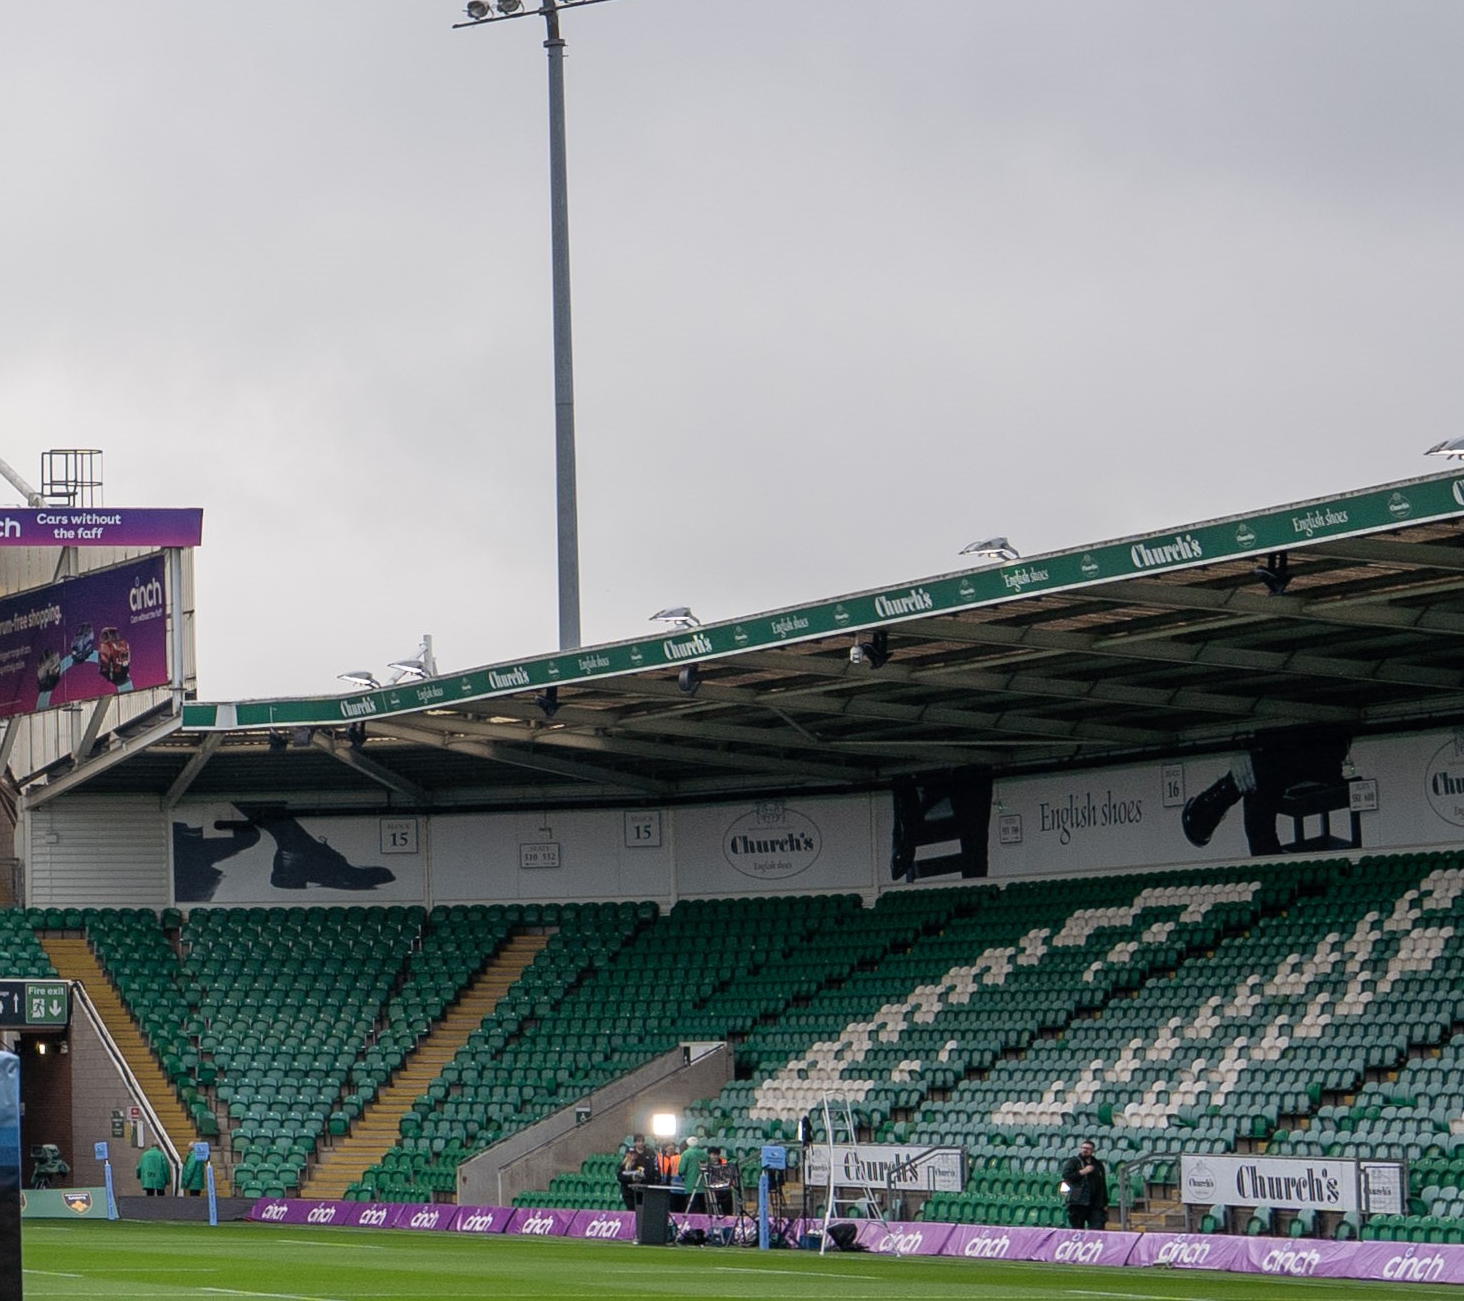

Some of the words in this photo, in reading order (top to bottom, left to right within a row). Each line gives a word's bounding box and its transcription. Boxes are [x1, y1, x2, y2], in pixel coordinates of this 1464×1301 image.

[36, 513, 68, 525] Cars
[71, 513, 120, 525] without
[1292, 514, 1321, 538] English
[1322, 508, 1348, 526] shoes
[54, 527, 74, 539] the
[78, 527, 102, 539] faff
[1130, 534, 1202, 569] Church's
[1005, 571, 1029, 592] English
[1030, 567, 1049, 583] shoes
[129, 576, 162, 612] cinch
[874, 587, 932, 618] Church's
[28, 602, 62, 631] shopping.
[771, 620, 791, 639] English
[792, 615, 808, 630] shoes
[663, 635, 712, 662] Church's
[488, 666, 529, 690] Church's
[340, 692, 376, 717] Church's
[1168, 781, 1180, 799] 16
[634, 824, 652, 839] 15
[1040, 798, 1099, 845] English
[1101, 796, 1143, 828] shoes
[390, 832, 408, 847] 15
[730, 831, 814, 856] Church's
[28, 986, 46, 995] Fire
[47, 987, 64, 996] exit
[1236, 1164, 1340, 1204] Church's
[262, 1198, 288, 1219] cinch
[308, 1201, 336, 1223] cinch
[359, 1203, 388, 1225] cinch
[411, 1206, 439, 1229] cinch
[463, 1208, 493, 1231] cinch
[522, 1210, 553, 1235] cinch
[586, 1213, 620, 1238] cinch
[879, 1226, 923, 1251] cinch
[965, 1230, 1010, 1258] cinch
[1055, 1232, 1104, 1262] cinch
[1159, 1233, 1210, 1264] cinch
[1261, 1241, 1320, 1275] cinch
[1382, 1246, 1445, 1279] cinch
